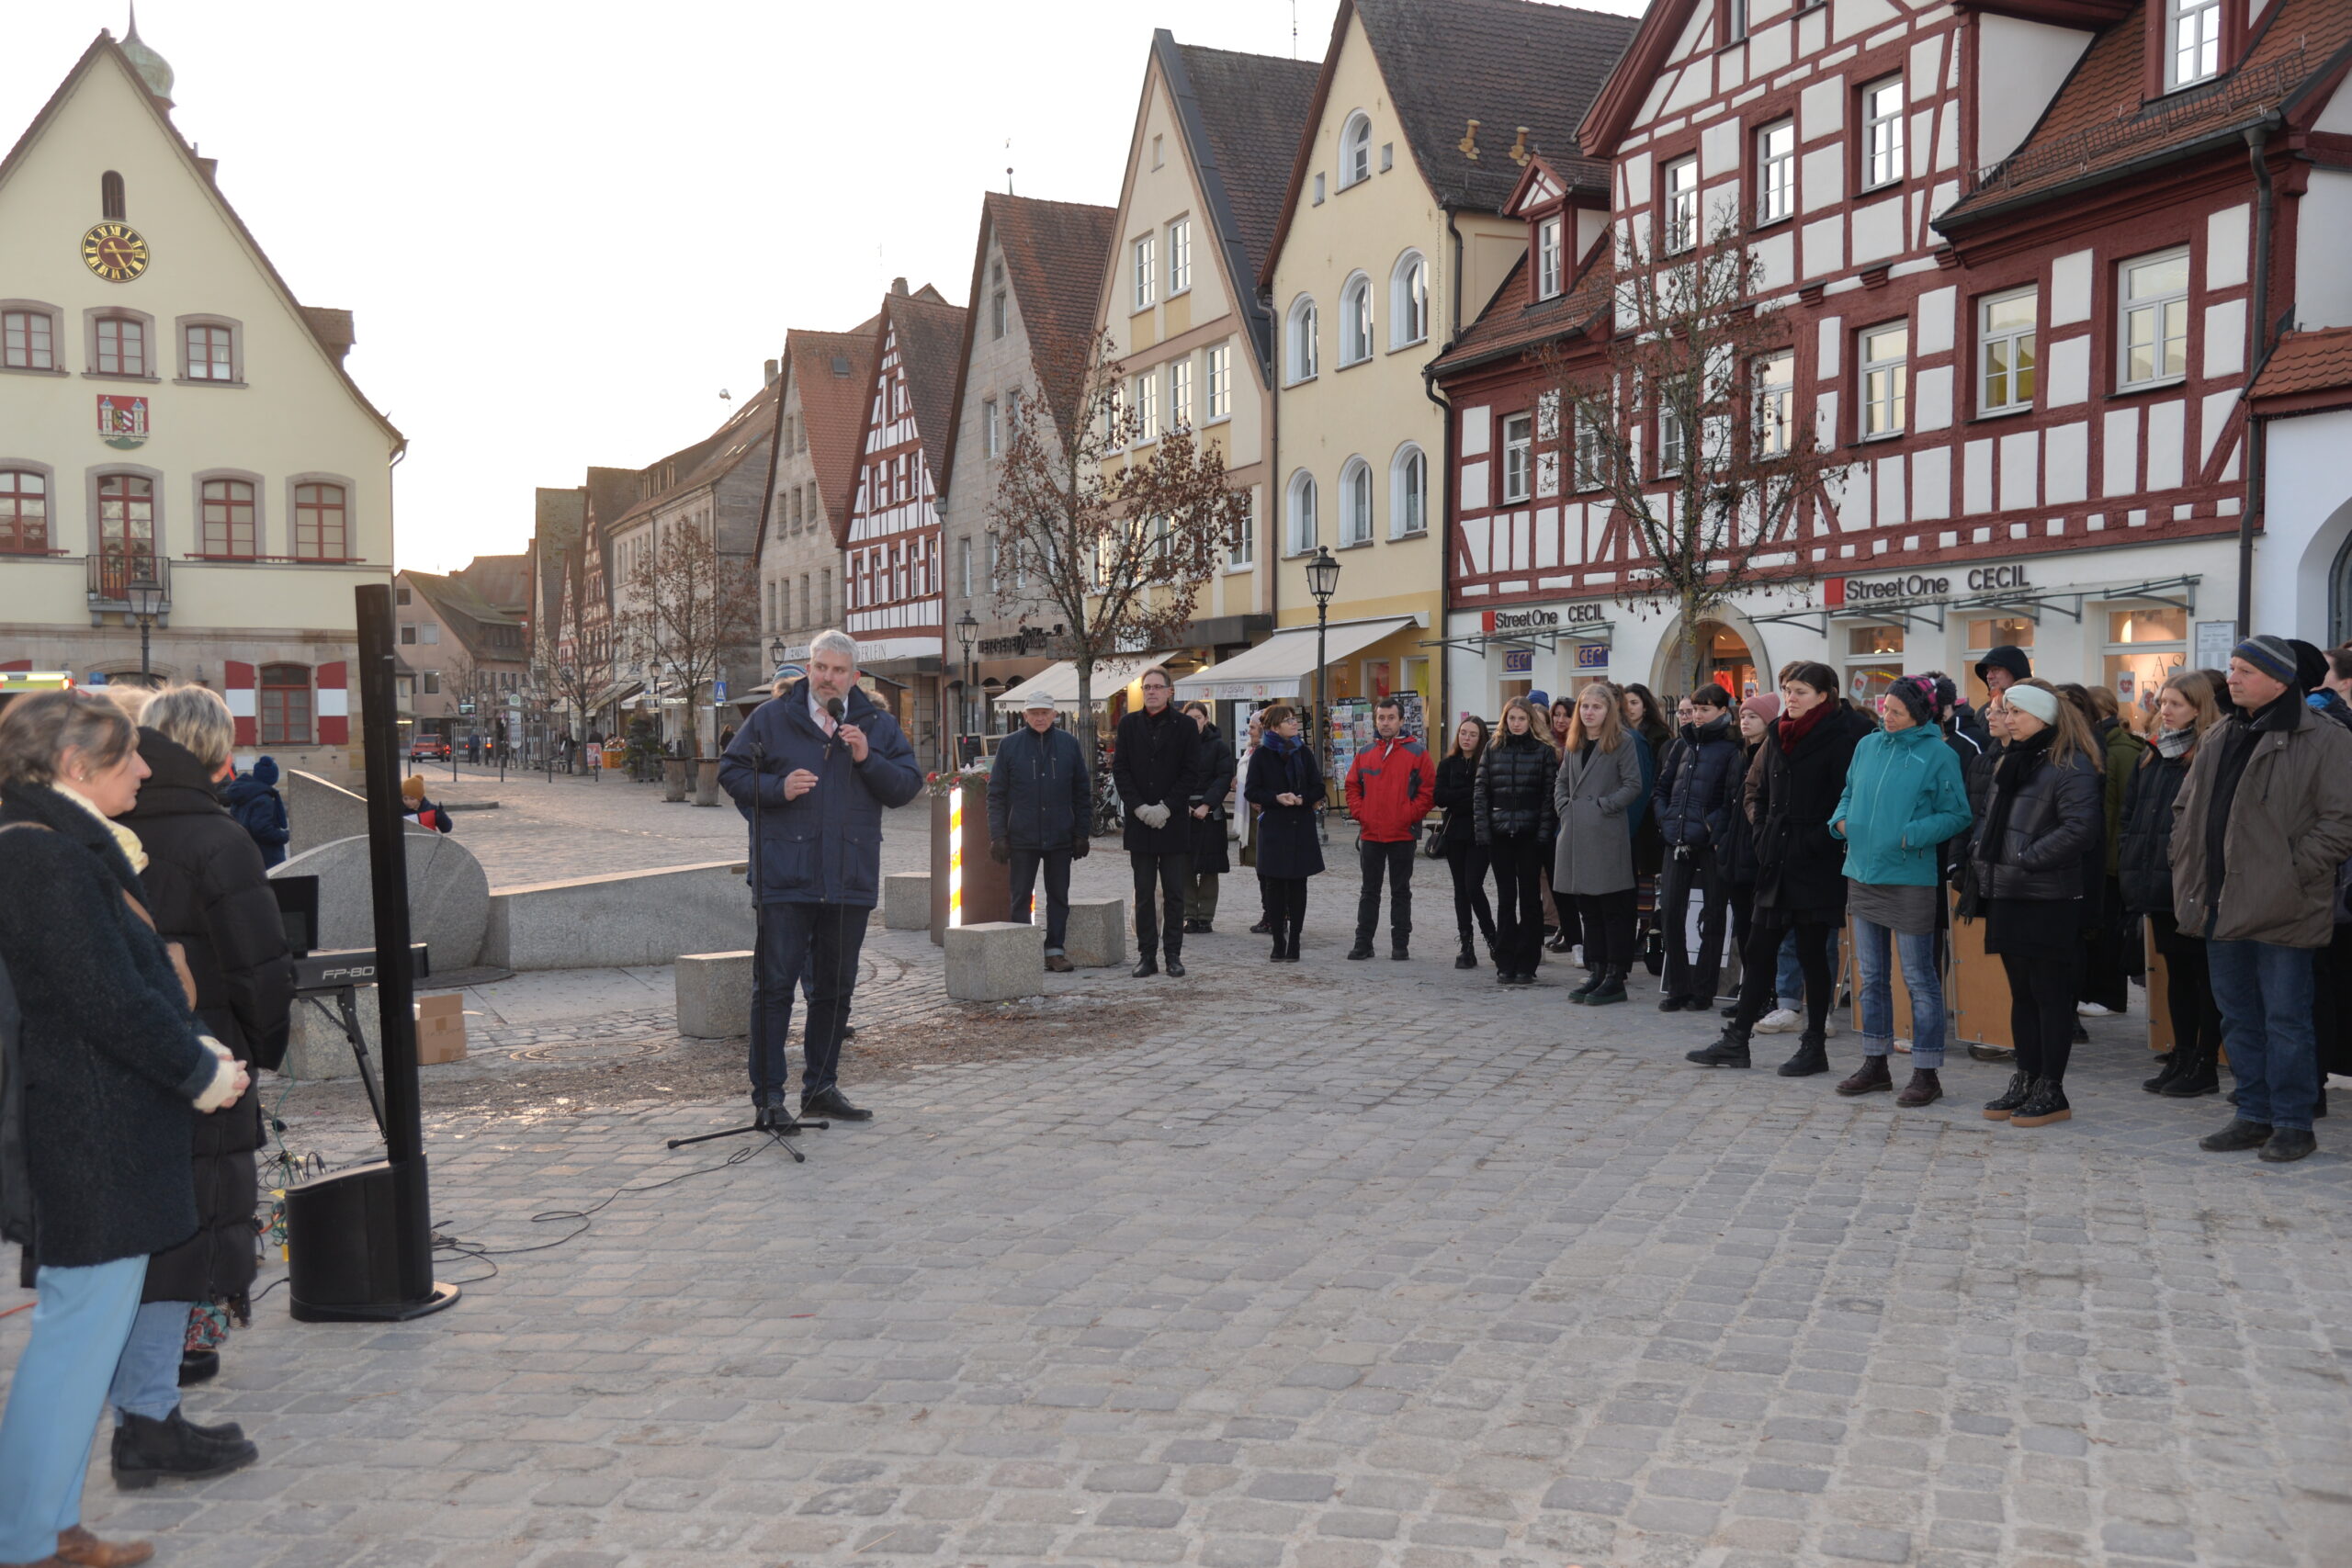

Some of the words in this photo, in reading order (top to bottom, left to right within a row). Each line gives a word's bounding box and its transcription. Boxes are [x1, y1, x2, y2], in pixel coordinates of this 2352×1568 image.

[1846, 577, 1905, 600] Street
[1906, 574, 1949, 596] One
[1967, 565, 2030, 591] CECIL
[1496, 611, 1531, 628] Street
[1532, 609, 1558, 625] One
[1567, 604, 1605, 623] CECIL
[322, 965, 375, 980] FP-80
